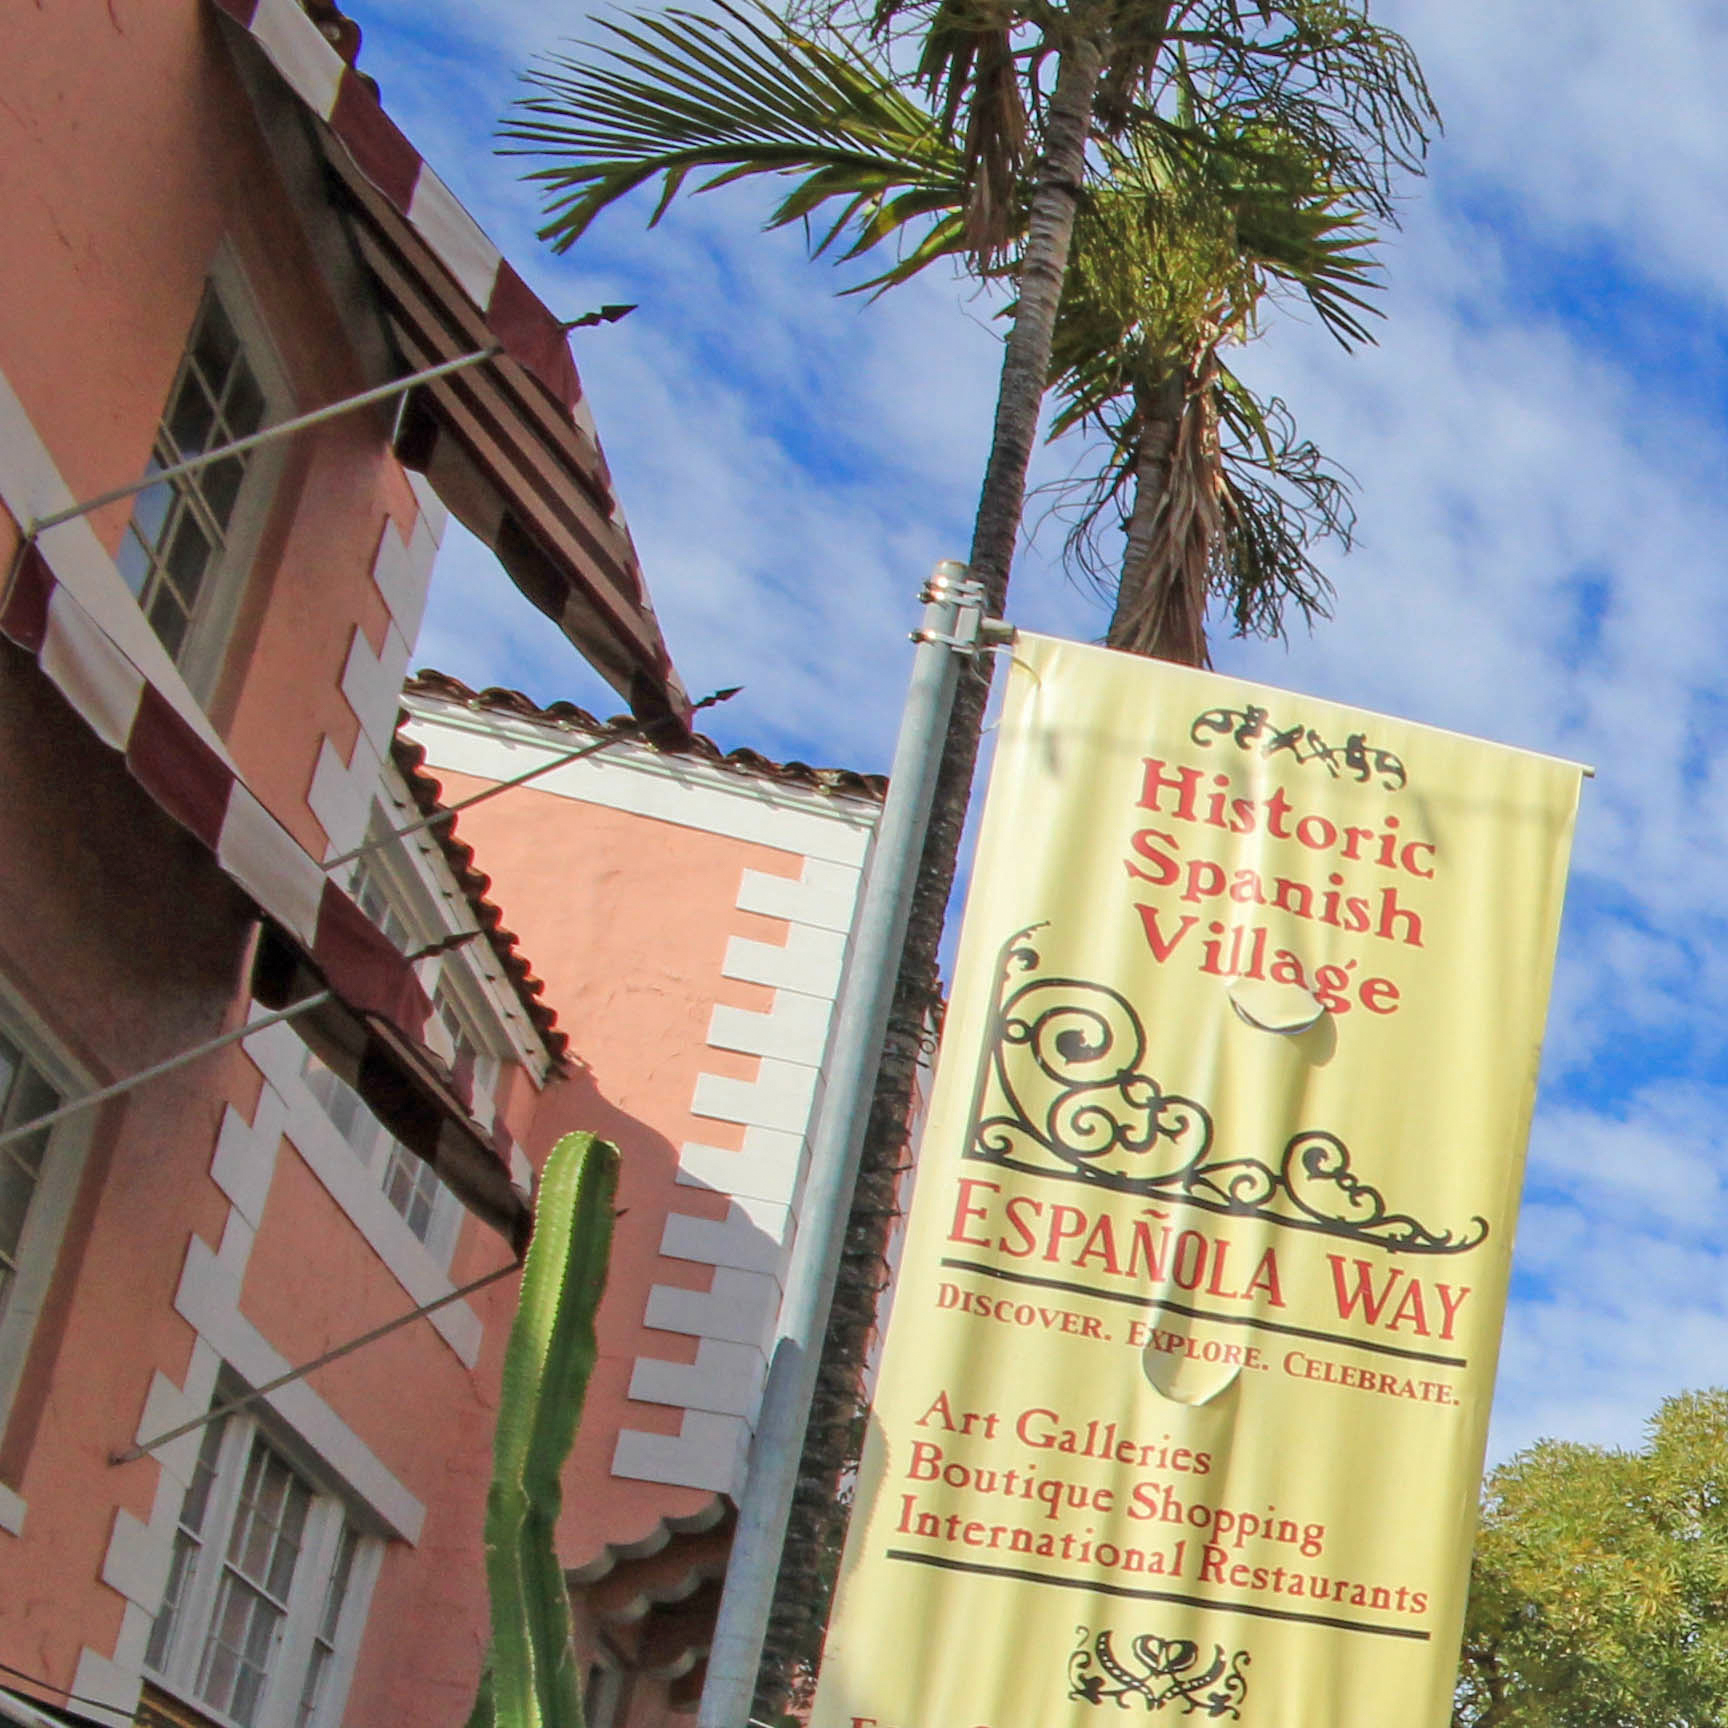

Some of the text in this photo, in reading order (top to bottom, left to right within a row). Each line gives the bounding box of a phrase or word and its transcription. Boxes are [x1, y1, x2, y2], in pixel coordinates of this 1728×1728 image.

[1134, 757, 1436, 879] Historic
[1124, 828, 1424, 946] Spanish
[1134, 903, 1401, 1015] Village
[947, 1178, 1470, 1340] ESPAÑOLA WAY
[936, 1283, 1459, 1405] DISCOVER. EXPLORE. CELEBRATE.
[916, 1390, 1211, 1474] Art Galleries
[896, 1494, 1428, 1614] International Restaurants
[904, 1440, 1326, 1557] Boutique Shopping
